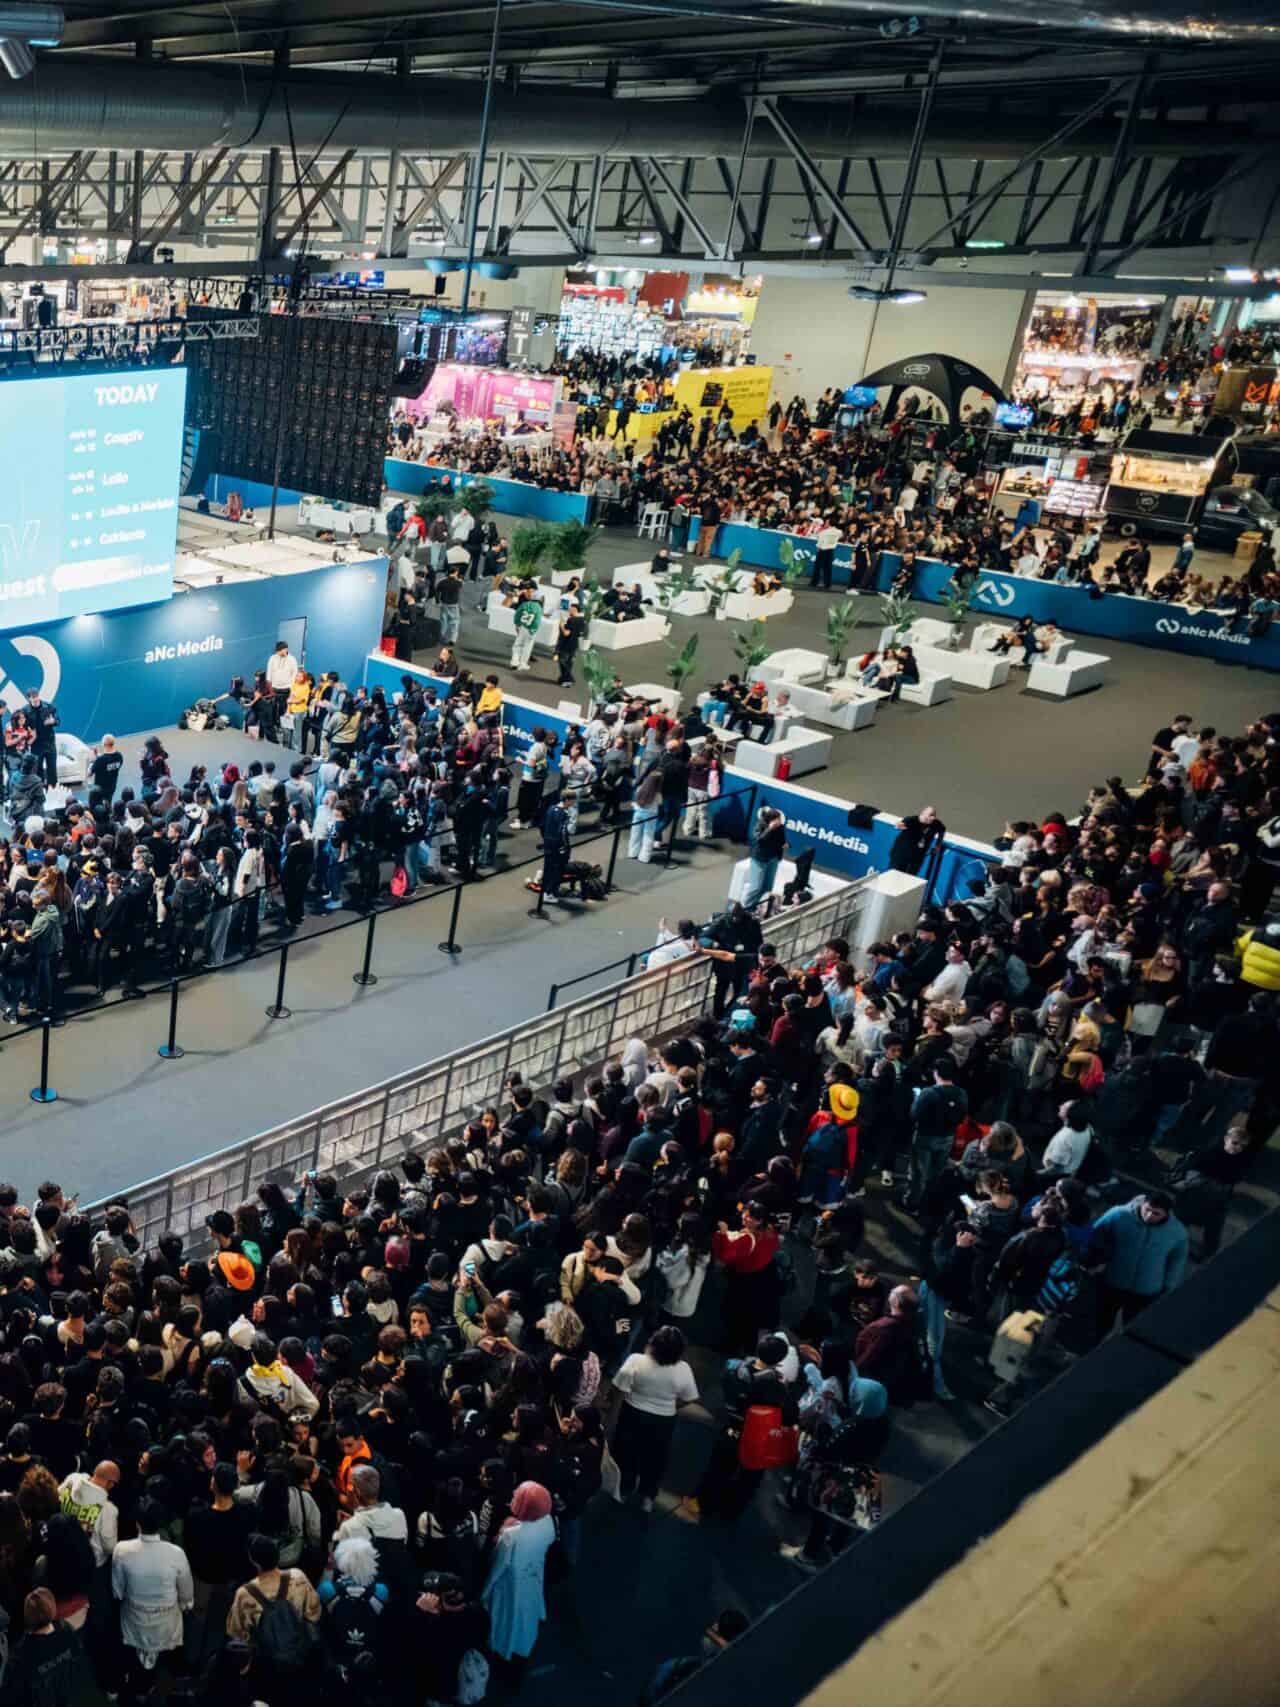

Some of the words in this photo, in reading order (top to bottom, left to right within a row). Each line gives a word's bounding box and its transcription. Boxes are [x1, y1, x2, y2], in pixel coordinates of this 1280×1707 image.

[94, 383, 159, 407] TODAY
[1180, 625, 1207, 637] aNc
[145, 646, 176, 664] aNc
[177, 635, 223, 657] Media
[786, 819, 818, 837] aNc
[818, 828, 869, 855] Media
